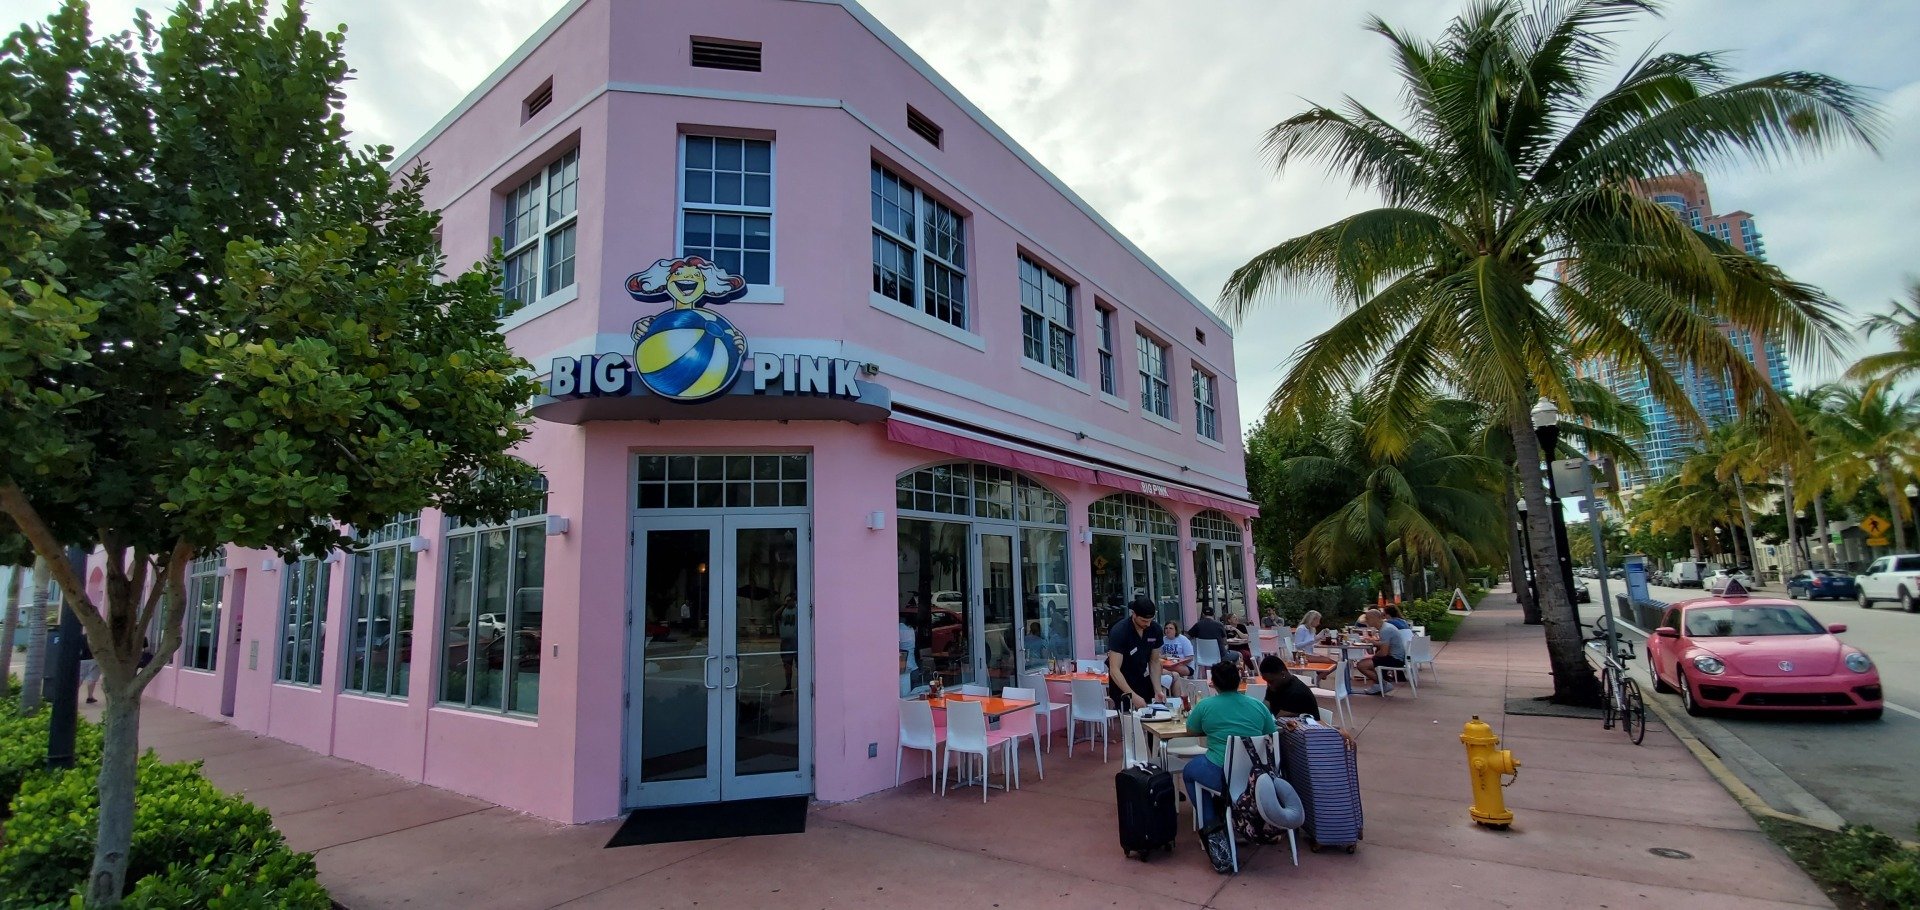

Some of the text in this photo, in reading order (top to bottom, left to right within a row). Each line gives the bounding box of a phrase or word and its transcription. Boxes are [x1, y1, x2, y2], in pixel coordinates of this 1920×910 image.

[551, 352, 862, 400] BIG PINK
[1141, 482, 1169, 497] BIG PINK
